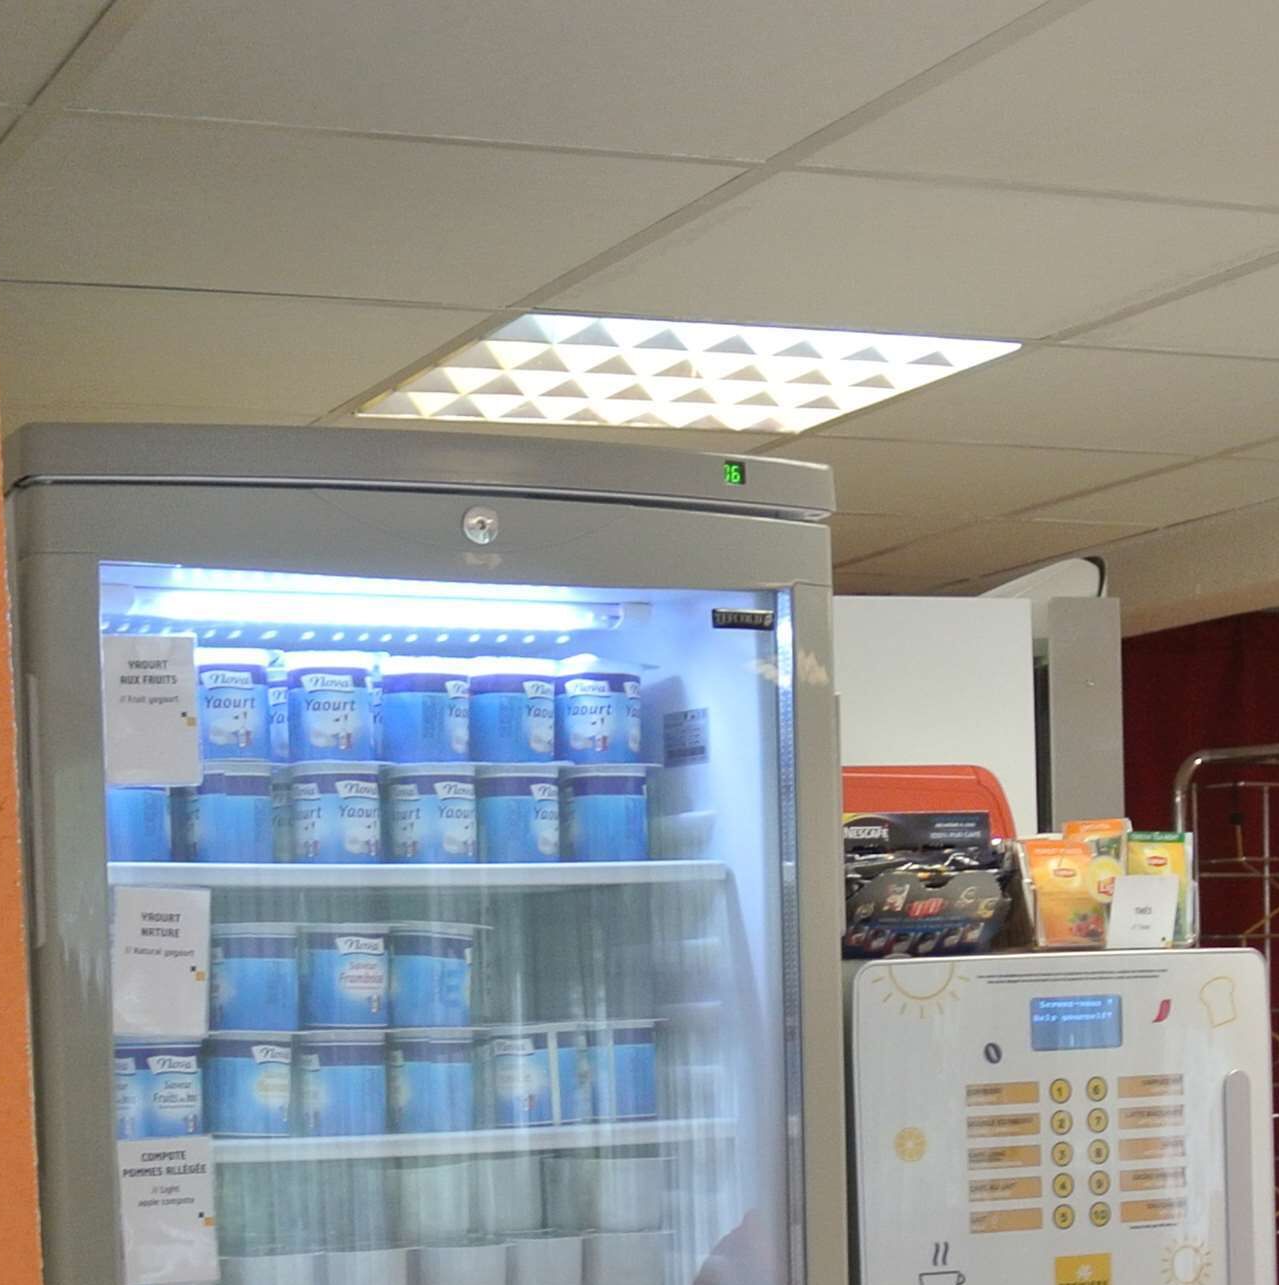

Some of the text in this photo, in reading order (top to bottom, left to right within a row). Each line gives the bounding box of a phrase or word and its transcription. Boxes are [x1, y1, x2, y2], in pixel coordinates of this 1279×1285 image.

[128, 660, 168, 669] YAOURT
[120, 675, 177, 684] AUX FRUITS
[204, 696, 256, 709] Yaourt
[305, 698, 356, 712] Yaourt
[142, 928, 180, 938] NATURE
[142, 1150, 186, 1161] COMPOTE
[123, 1167, 162, 1177] POMMES
